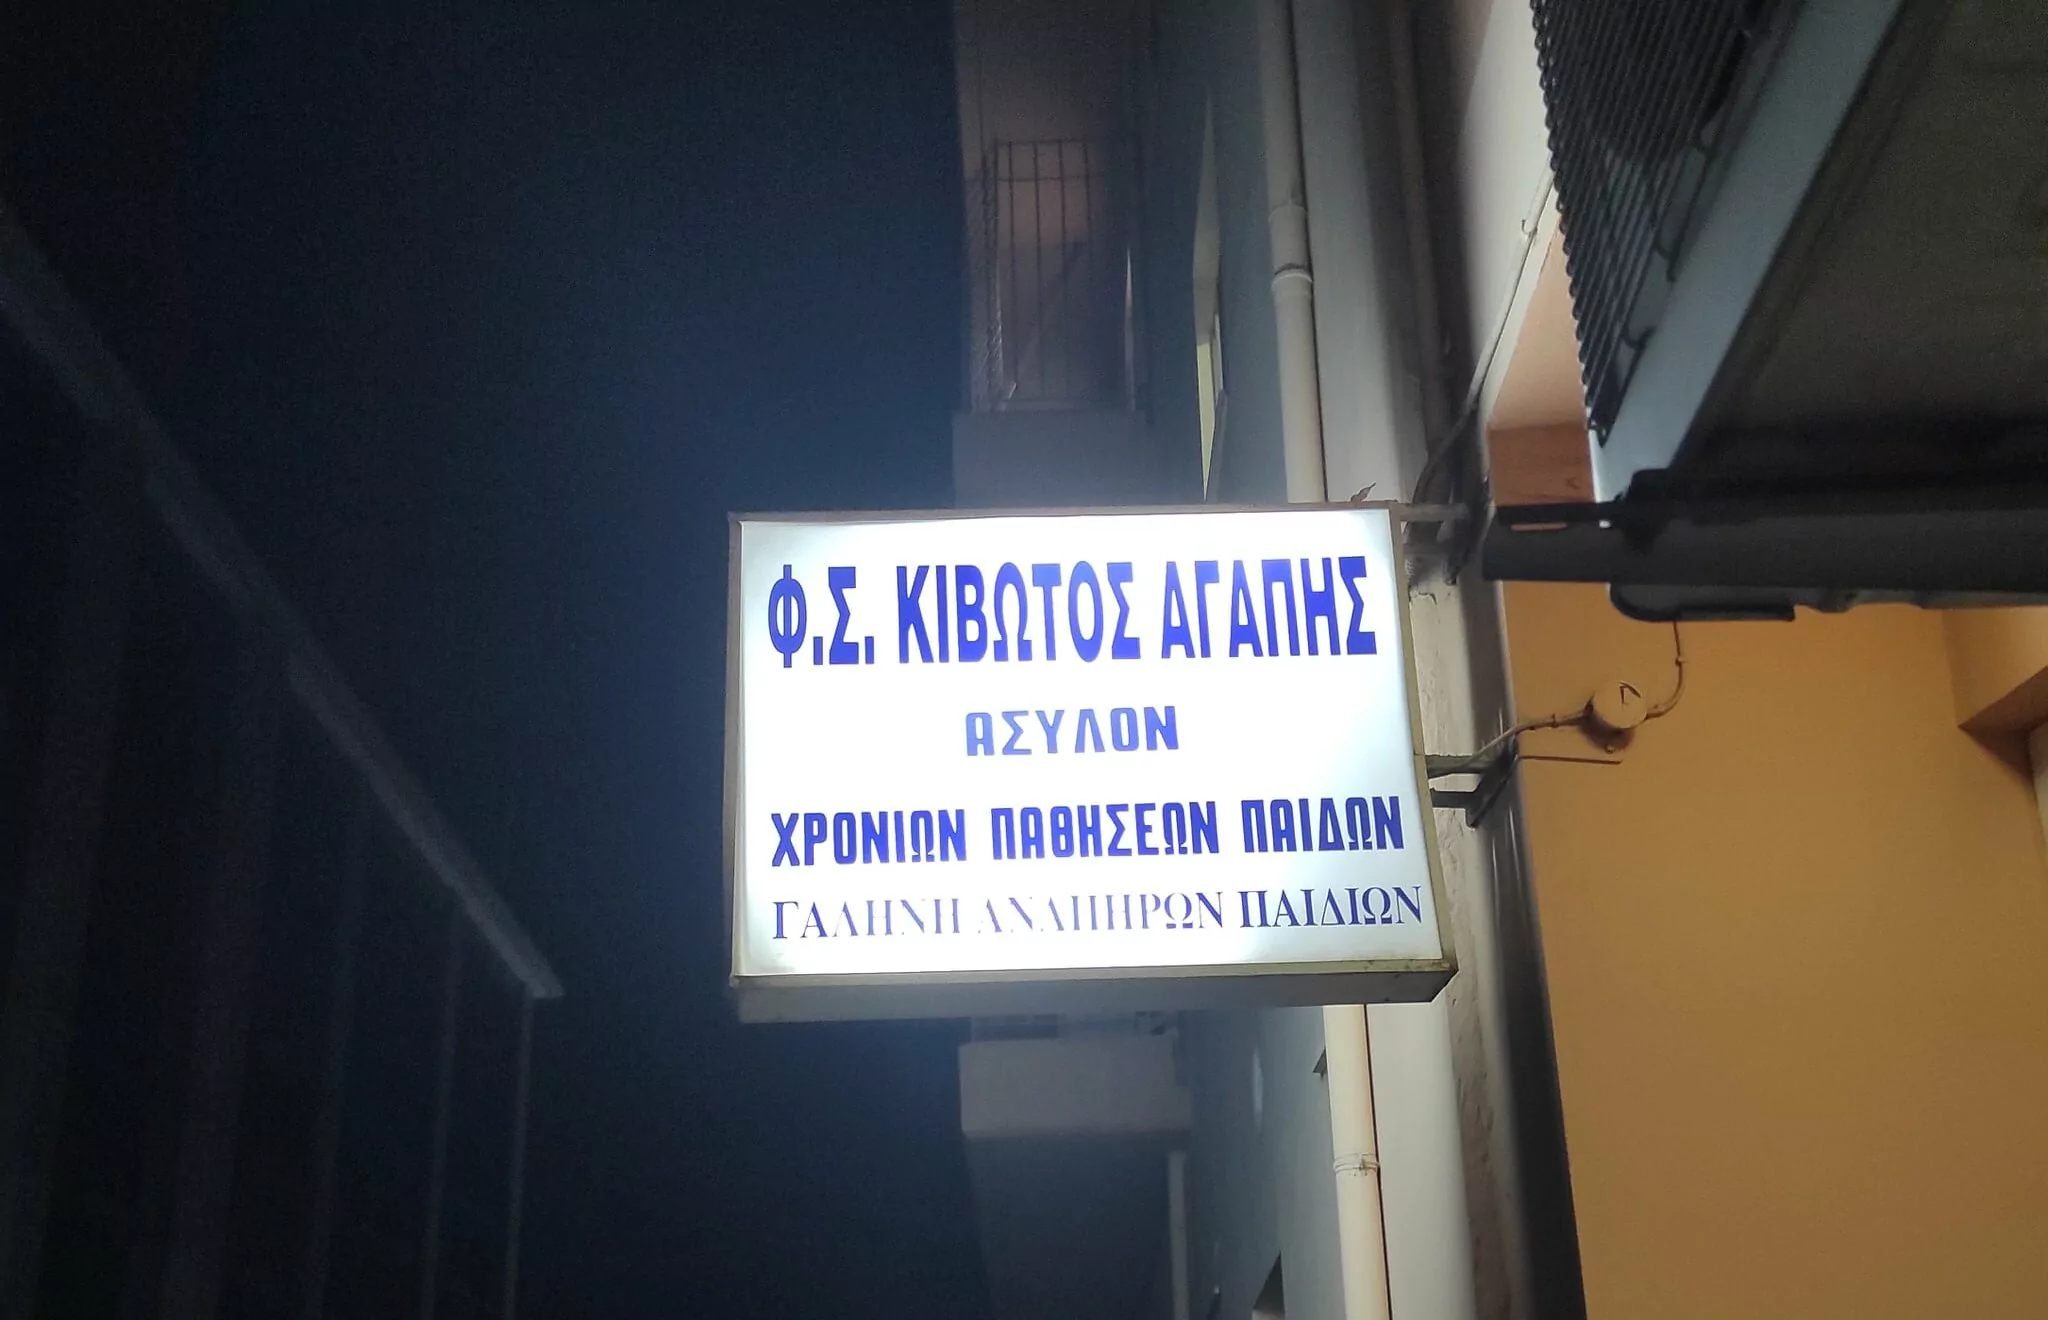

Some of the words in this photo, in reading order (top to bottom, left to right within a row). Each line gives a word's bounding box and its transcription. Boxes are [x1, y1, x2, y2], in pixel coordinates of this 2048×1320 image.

[768, 564, 875, 668] Φ.Σ.
[896, 562, 1141, 664] ΚΙΒΩΤΟΣ
[1162, 557, 1377, 659] ΑΓΑΠΗΣ
[965, 706, 1179, 756] ΑΣΥΛΟΝ
[771, 810, 966, 867] ΧΡΟΝΙΩΝ
[991, 802, 1219, 860] ΠΑΘΗΣΕΩΝ
[1241, 795, 1404, 856] ΠΑΙΔΩΝ
[1238, 885, 1423, 928] ΠΑΙΔΙΩΝ
